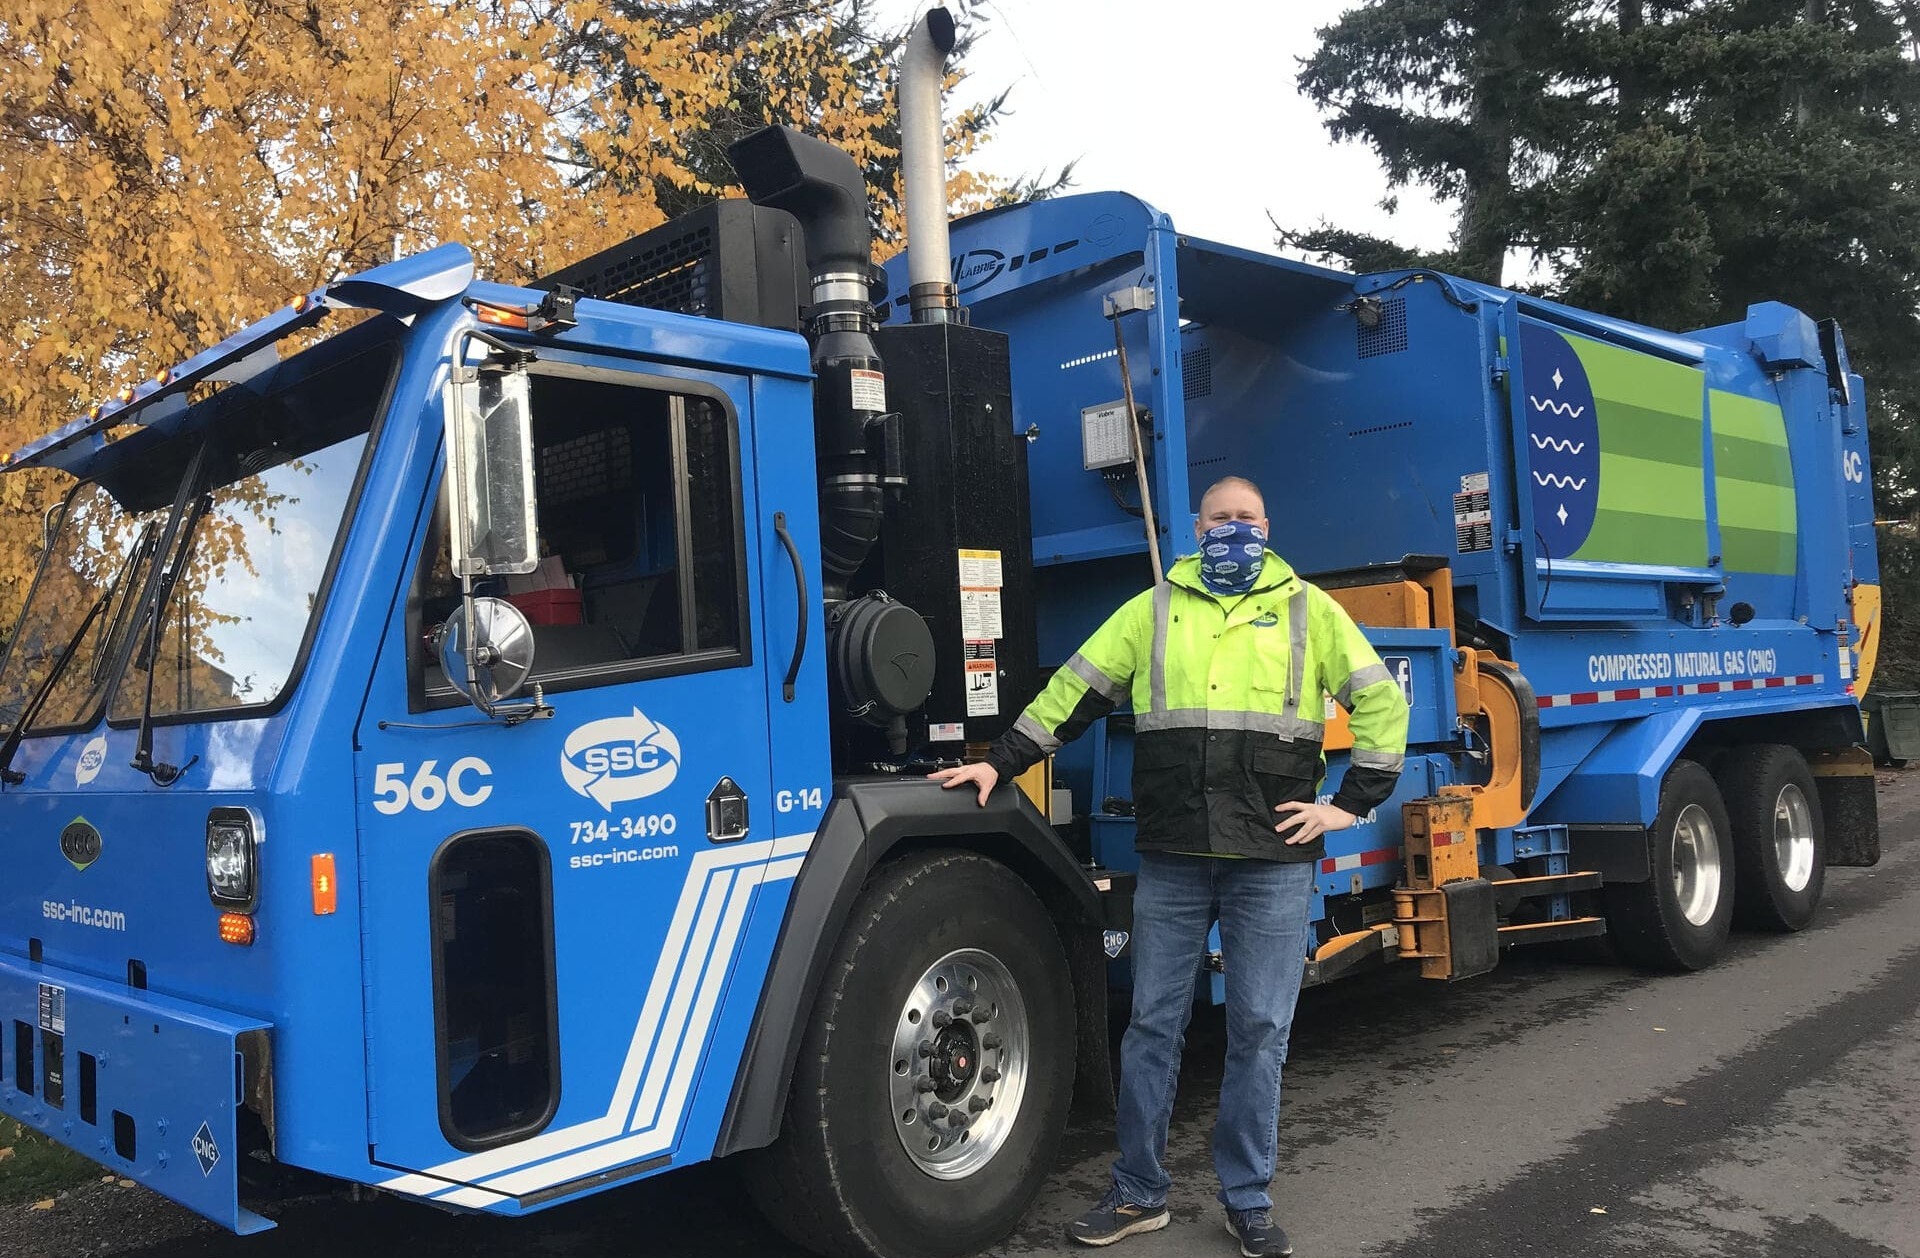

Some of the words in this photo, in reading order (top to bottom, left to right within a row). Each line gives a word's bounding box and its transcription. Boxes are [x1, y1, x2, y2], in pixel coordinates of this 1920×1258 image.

[1844, 450, 1863, 483] 6C
[1588, 653, 1672, 683] COMPRESSED
[1675, 651, 1723, 678] NATURAL
[1724, 650, 1745, 675] GAS
[1747, 648, 1776, 675] (CNG)
[82, 753, 100, 767] SSC
[584, 745, 660, 773] SSC
[373, 756, 493, 815] 56C
[776, 788, 823, 813] G-14
[569, 814, 677, 844] 734-3490
[570, 843, 678, 869] ssc-inc.com
[43, 899, 126, 931] ssc-inc.com
[1104, 933, 1122, 948] CNG
[195, 1137, 216, 1161] CNG
